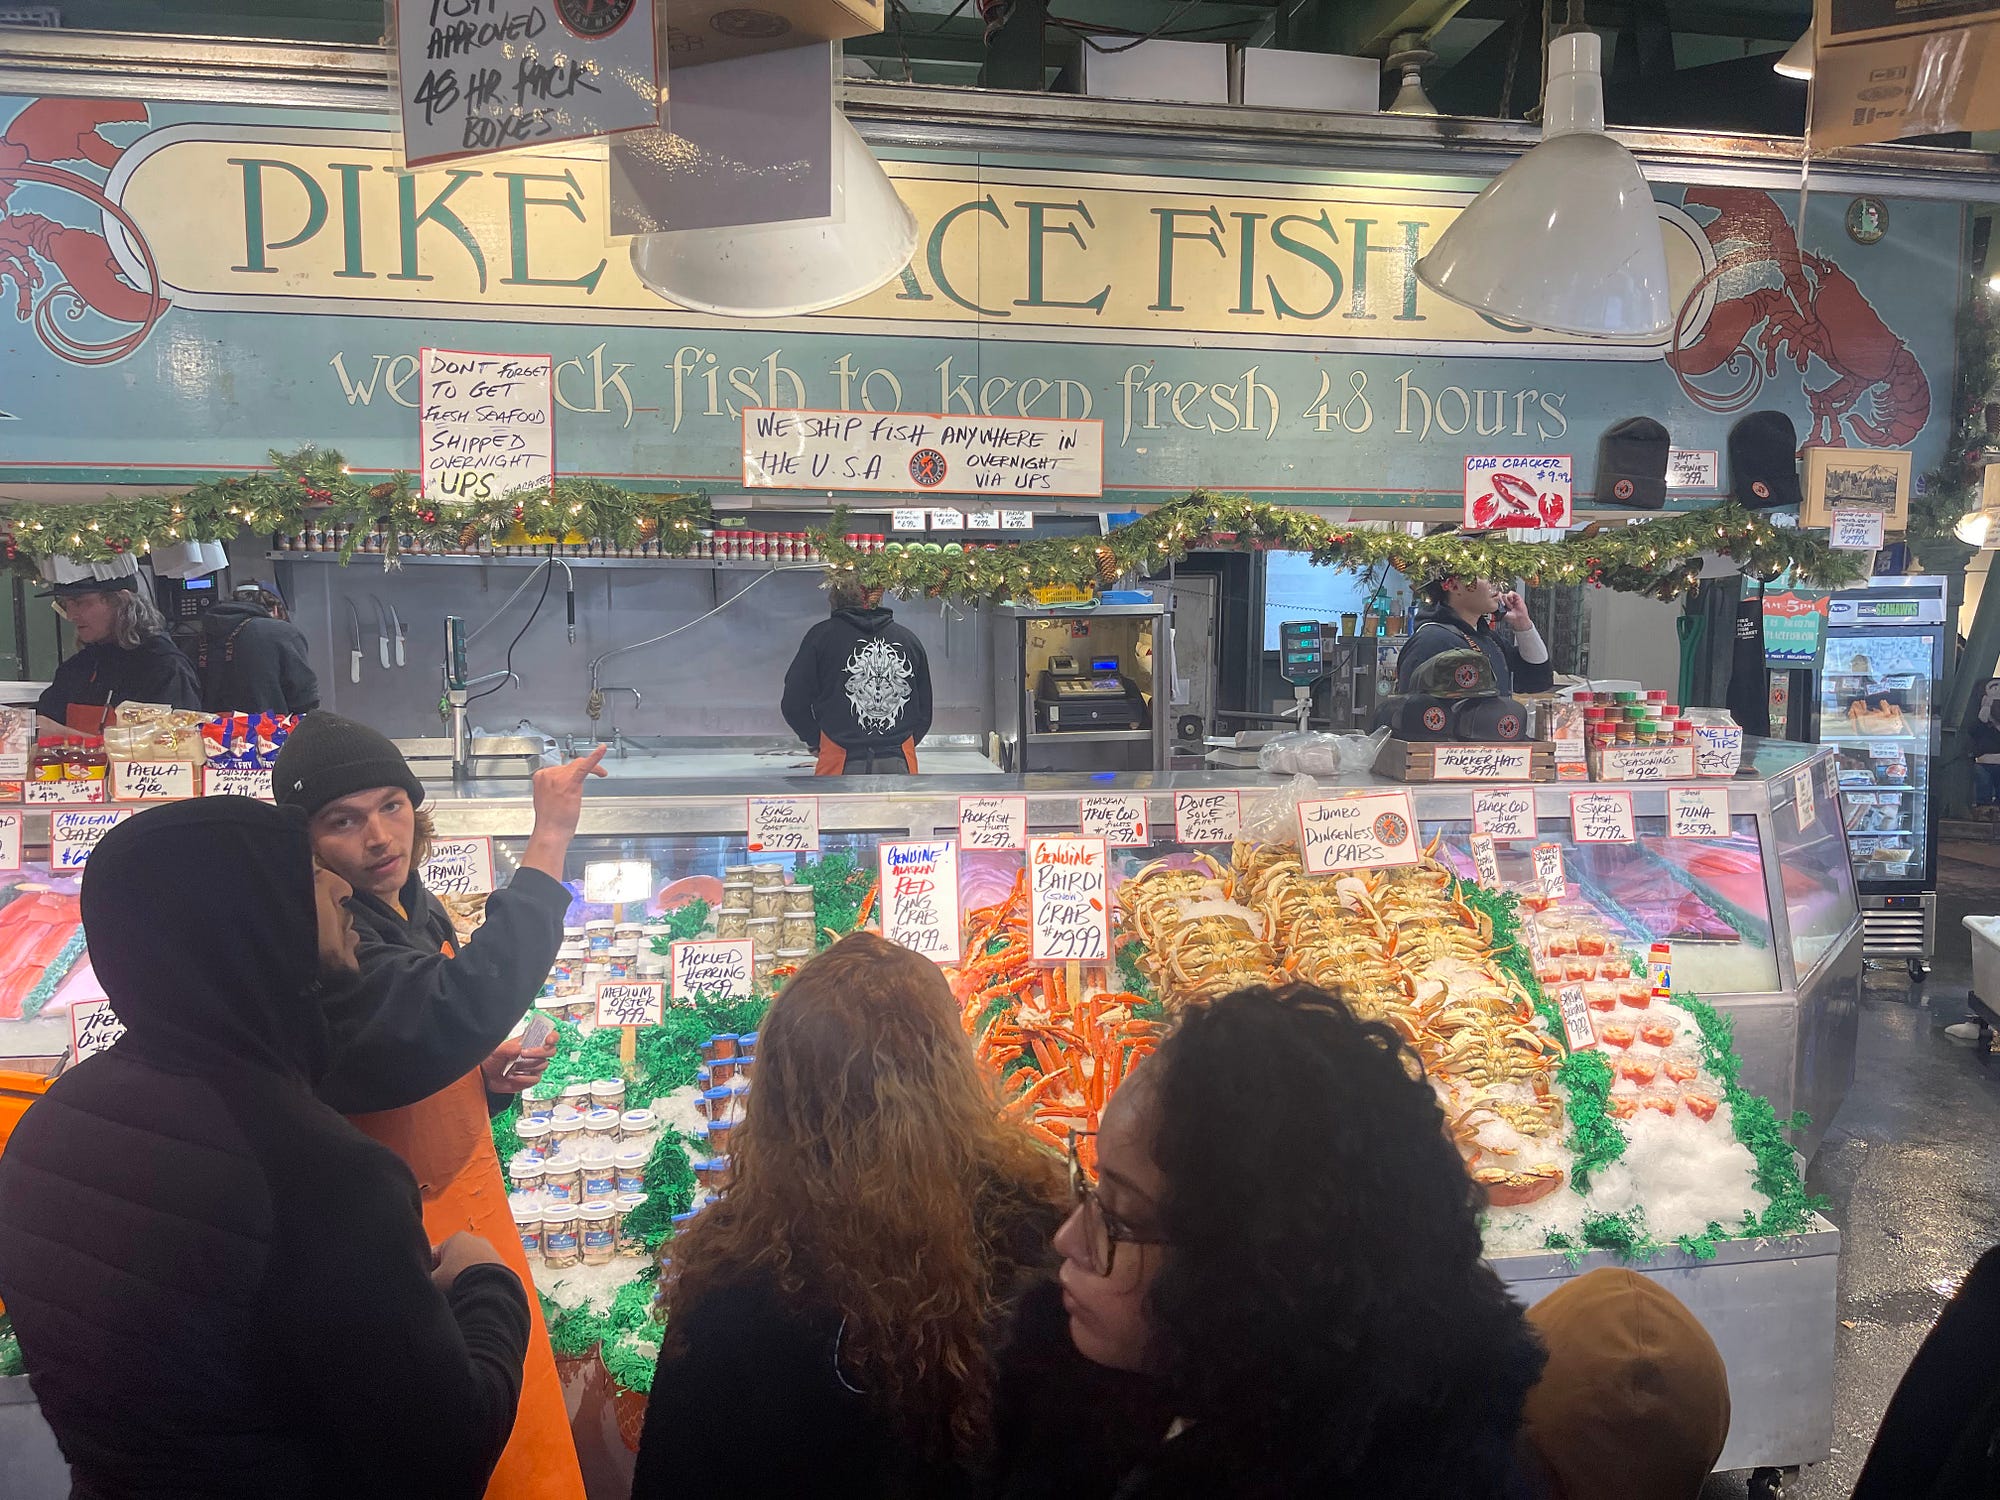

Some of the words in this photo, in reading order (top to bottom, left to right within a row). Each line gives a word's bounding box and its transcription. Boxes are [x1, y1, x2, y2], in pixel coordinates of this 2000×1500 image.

[427, 5, 547, 59] APPROVED
[414, 69, 460, 125] 48
[512, 56, 602, 106] PACK
[462, 107, 554, 149] BOXES
[227, 158, 607, 294] PIKE
[1148, 205, 1430, 321] FISH
[497, 362, 550, 379] FORGET
[329, 350, 420, 409] we
[552, 342, 636, 430] ck
[664, 345, 807, 434] fish
[829, 352, 903, 415] to
[1116, 364, 1281, 448] fresh
[1302, 370, 1373, 434] 48
[1395, 368, 1568, 442] hours
[432, 380, 457, 398] TO
[469, 381, 525, 398] GET
[422, 405, 470, 423] FRESH
[475, 405, 546, 424] SEAFOOD
[757, 417, 799, 440] WE
[941, 424, 1048, 448] ANYWHERE
[429, 430, 526, 454] SHIPPED
[430, 454, 547, 470] OVERNIGHT
[757, 451, 804, 476] THE
[966, 454, 1075, 471] OVERNIGHT
[1467, 458, 1497, 471] CRAB
[1502, 458, 1562, 469] CRACKER
[1673, 452, 1701, 461] HATS
[1673, 462, 1709, 472] BEANIES
[440, 471, 496, 498] UPS
[975, 473, 1008, 489] VIA
[1014, 474, 1052, 490] UPS
[1875, 602, 1918, 616] SEAHAWKS
[1696, 729, 1717, 738] WE
[1724, 729, 1741, 738] LO
[1707, 739, 1739, 748] TIPS
[1438, 755, 1493, 766] TRUCKER
[1495, 754, 1524, 767] HATS
[1612, 756, 1679, 768] SEASONINGS
[127, 763, 187, 777] PAELLA
[216, 768, 268, 777] LOUISIANA
[139, 776, 158, 784] MIX
[254, 777, 271, 786] FISH
[1087, 796, 1127, 806] ALASKAN
[1177, 795, 1225, 812] DOVER
[1475, 799, 1509, 813] BLACK
[1508, 800, 1529, 813] COD
[1576, 803, 1623, 814] SWORD
[56, 809, 120, 828] CHILEAN
[755, 810, 811, 824] SALMON
[761, 805, 793, 816] KING
[1083, 807, 1116, 821] TRUE
[1116, 806, 1140, 820] COD
[1187, 809, 1222, 820] SOLE
[1308, 805, 1361, 822] JUMBO
[1582, 814, 1616, 824] FISH
[1675, 806, 1716, 819] TUNA
[1305, 823, 1376, 847] DUNGENESS
[431, 843, 478, 858] UMBO
[1034, 842, 1103, 866] GENUINE
[1324, 843, 1385, 867] CRABS
[424, 863, 478, 881] PRAWNS
[892, 864, 936, 876] ALASKAN
[1034, 865, 1103, 892] BAIRDI
[426, 876, 470, 895] 2999
[893, 877, 935, 898] RED
[894, 893, 932, 914] KING
[897, 909, 939, 925] CRAB
[1037, 901, 1092, 926] CRAB
[679, 945, 743, 968] PICKLED
[677, 965, 746, 984] HERRING
[601, 986, 652, 999] MEDIUM
[610, 997, 659, 1010] OYSTER
[79, 1013, 120, 1031] TRE
